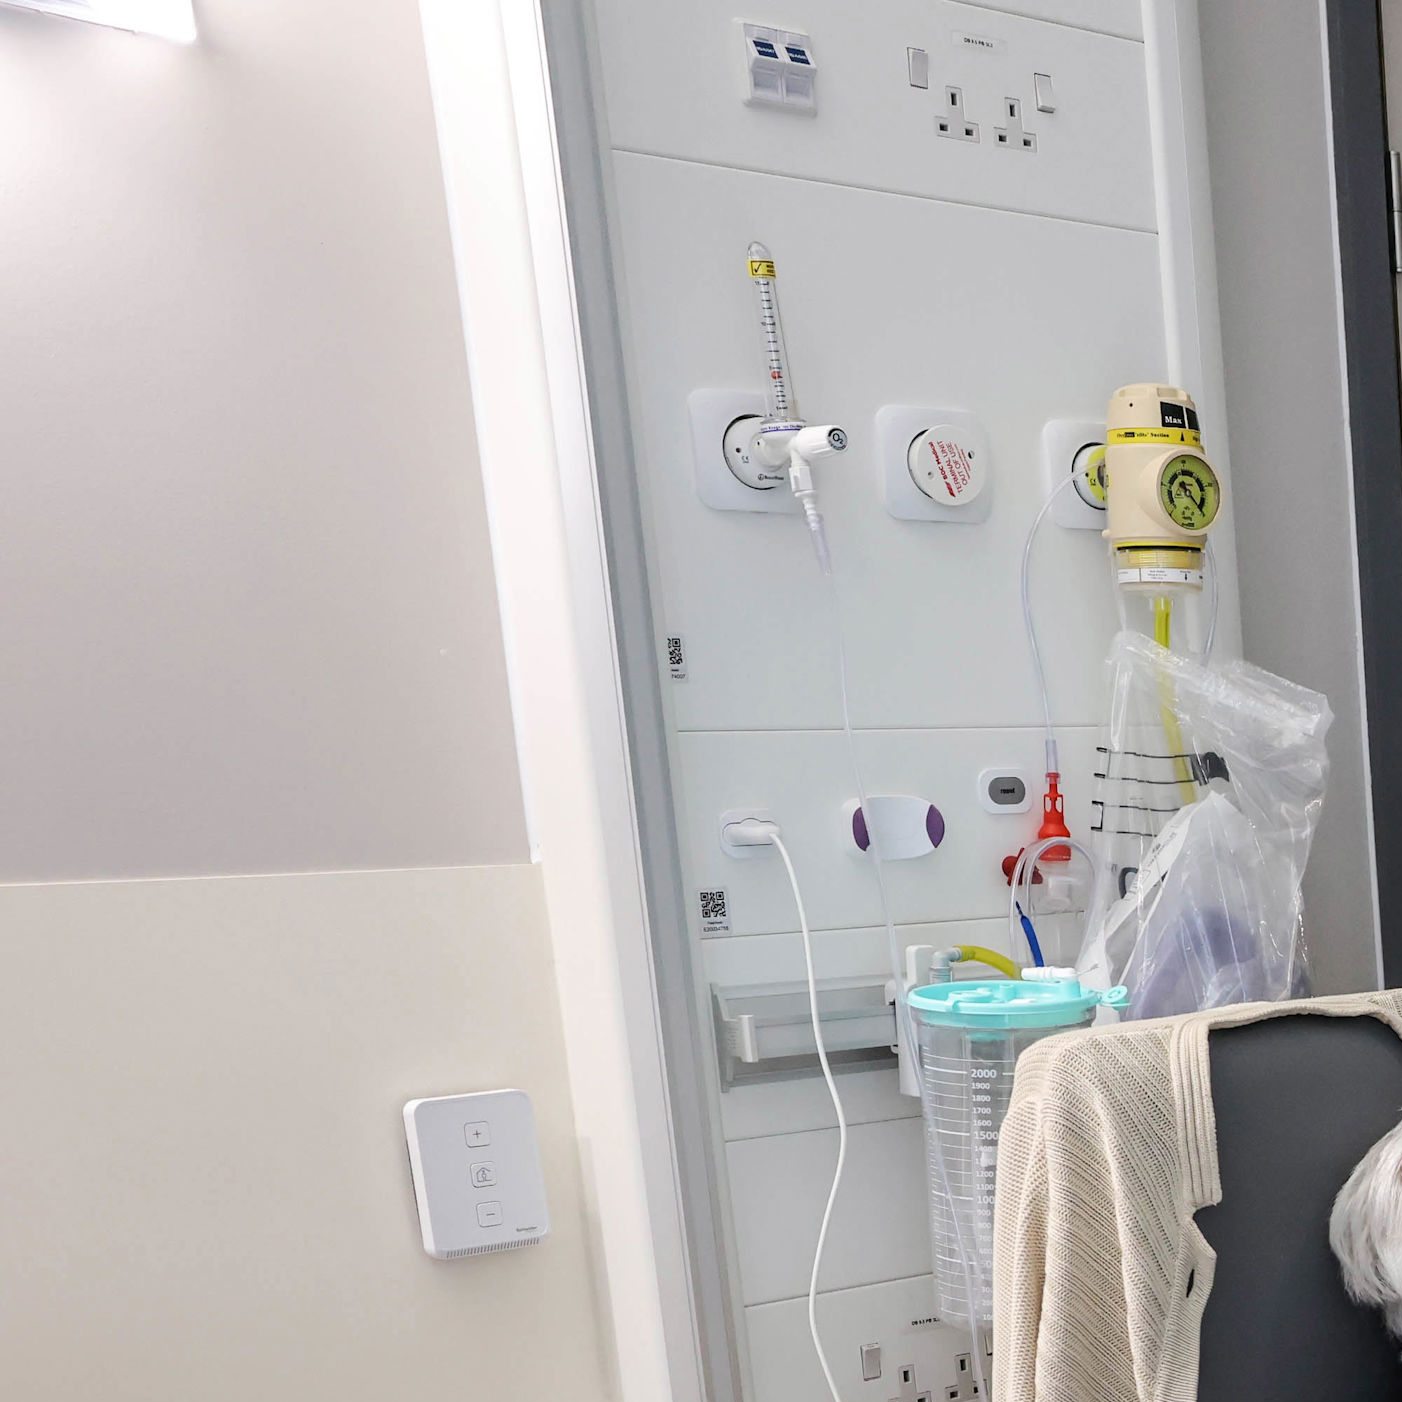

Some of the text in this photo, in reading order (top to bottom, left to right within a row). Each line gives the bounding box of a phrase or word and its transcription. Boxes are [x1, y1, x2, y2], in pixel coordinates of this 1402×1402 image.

[1164, 415, 1183, 425] Max
[936, 440, 949, 458] UNIT
[945, 442, 957, 458] USE
[952, 459, 962, 470] OF
[945, 457, 964, 494] TERMINAL
[957, 470, 969, 486] OUT
[970, 1068, 997, 1079] 2000
[971, 1082, 991, 1090] 1900
[972, 1094, 991, 1102] 1800
[972, 1107, 992, 1115] 1700
[973, 1119, 992, 1127] 1600
[974, 1131, 998, 1141] 1500
